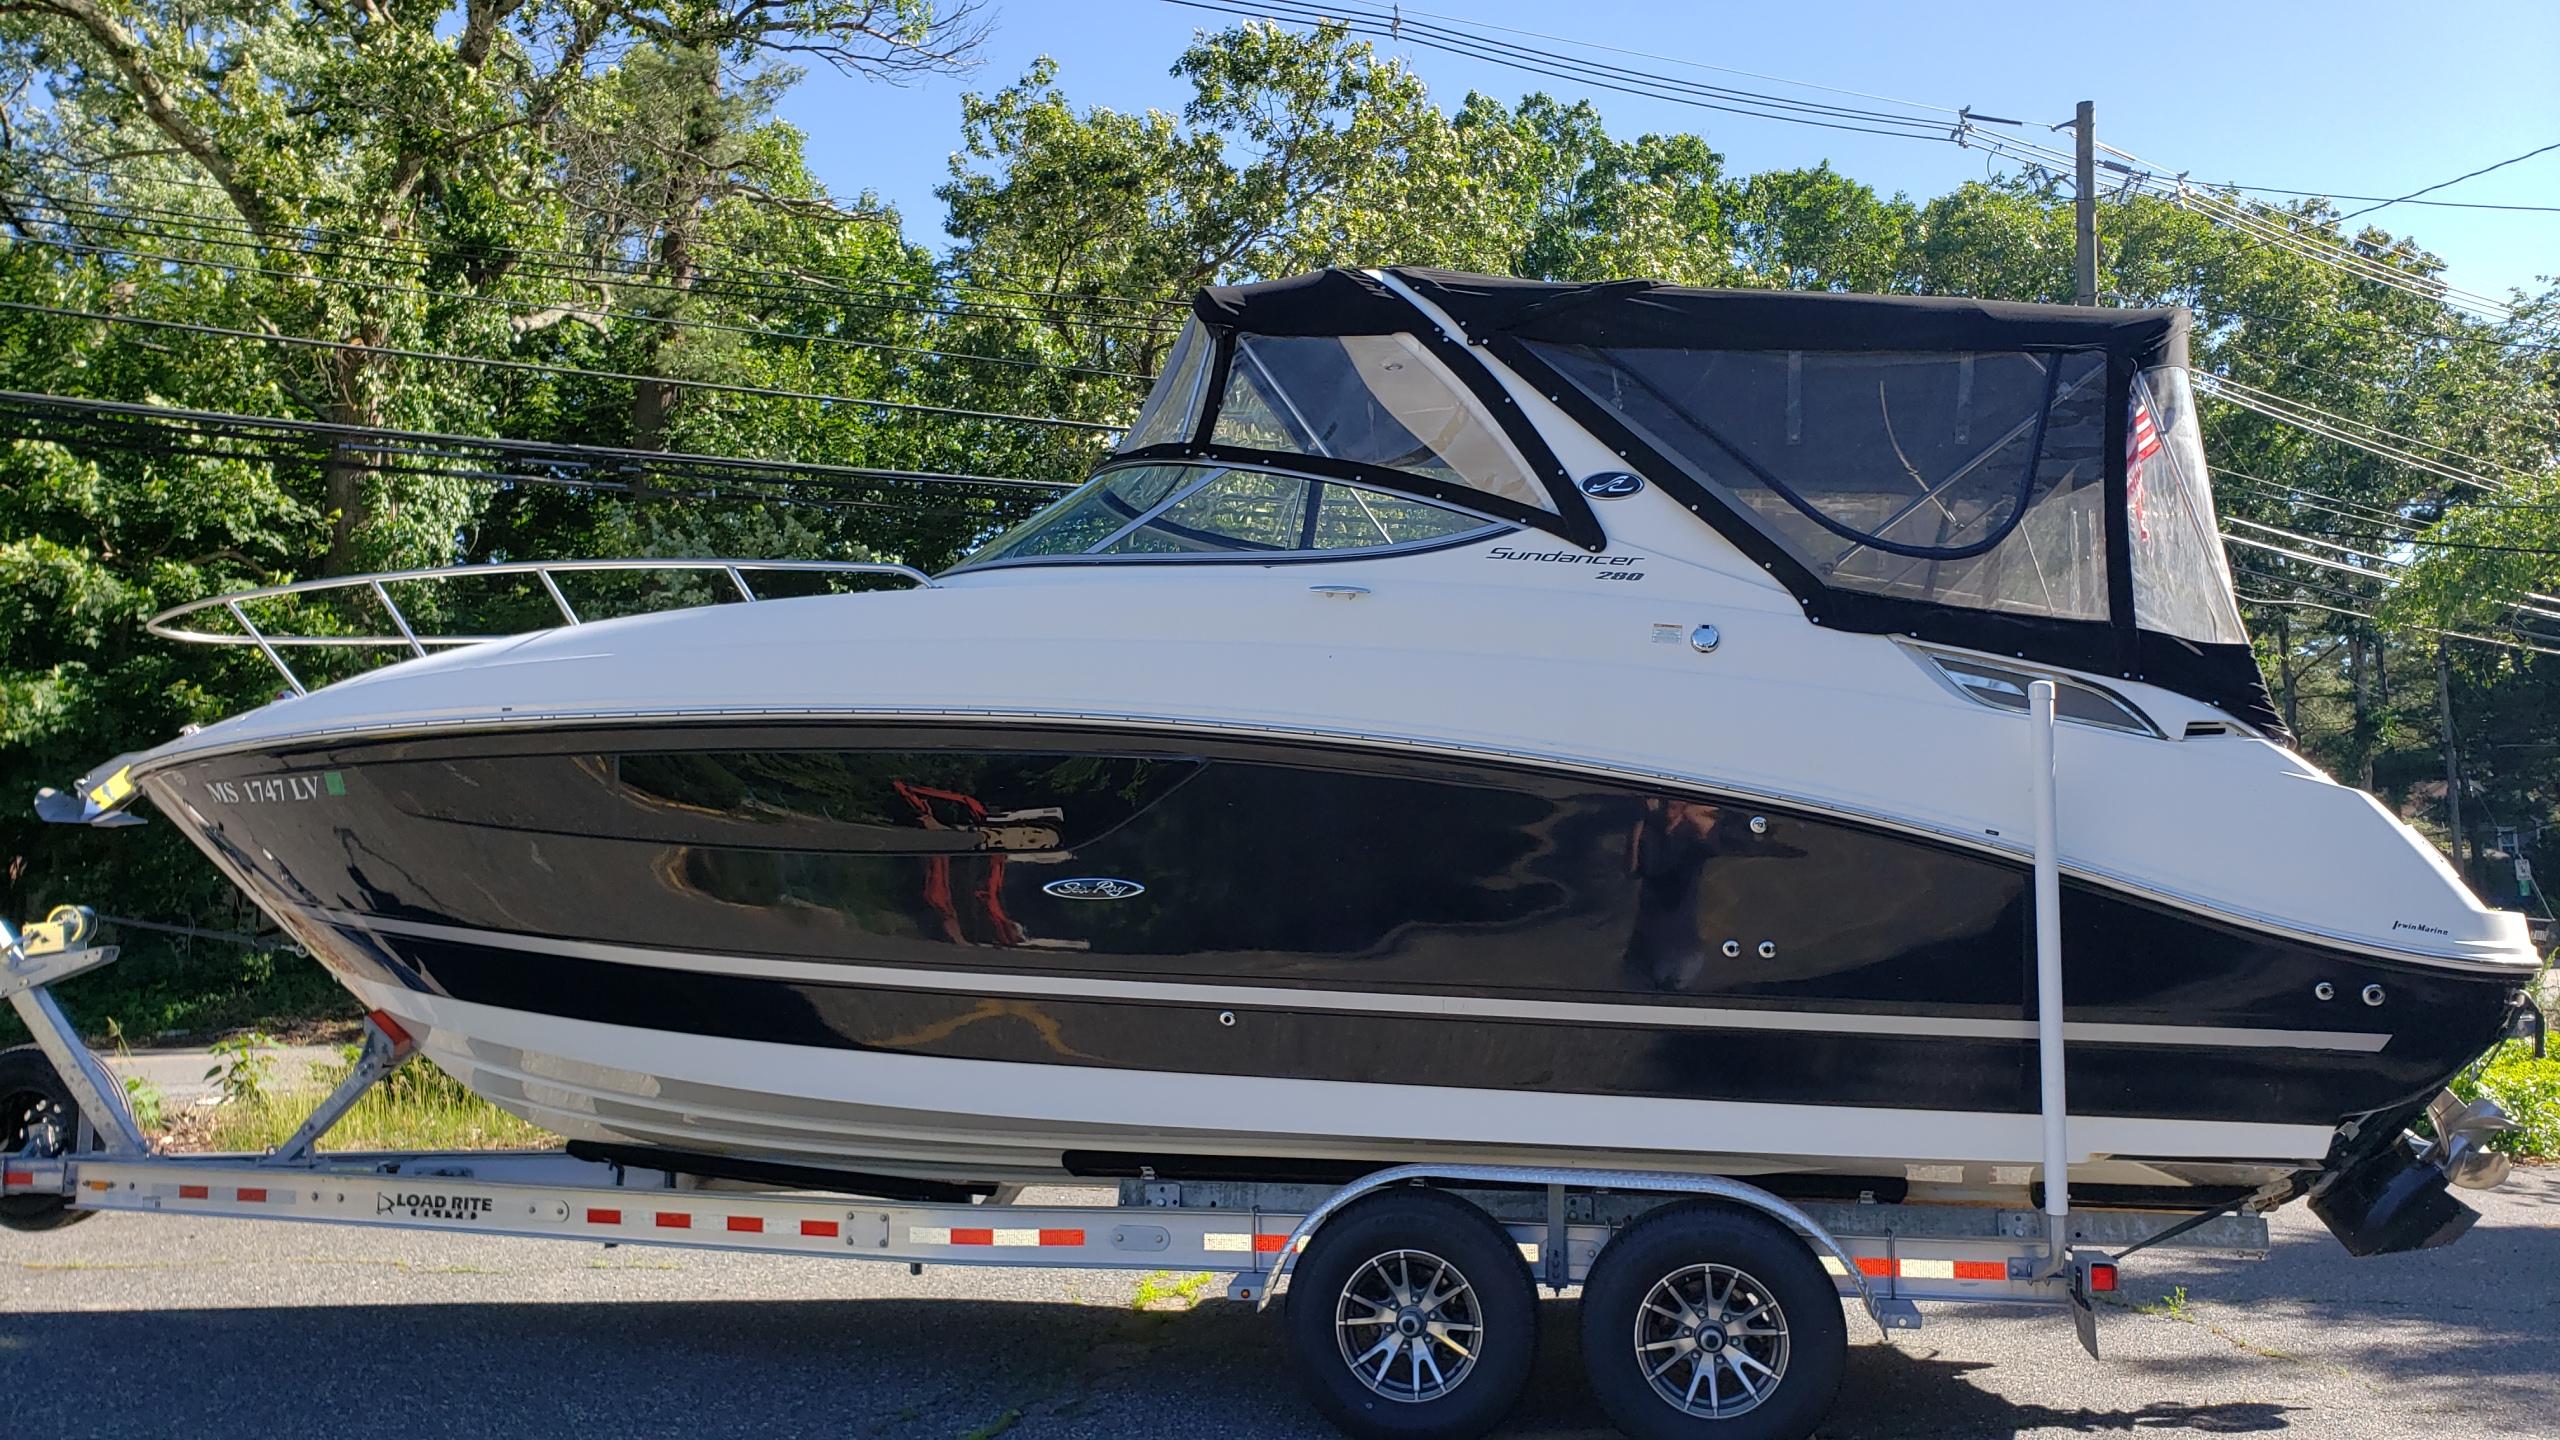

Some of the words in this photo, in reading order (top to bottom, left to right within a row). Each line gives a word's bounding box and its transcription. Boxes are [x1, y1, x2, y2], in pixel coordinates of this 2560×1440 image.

[1486, 547, 1645, 566] Sundancer
[1595, 571, 1645, 581] 280
[205, 781, 239, 803] MS
[243, 778, 285, 803] 1747
[288, 776, 318, 800] LV
[1057, 881, 1089, 894] Sea
[1091, 880, 1128, 897] Ray
[396, 1193, 447, 1209] LOAD
[451, 1196, 493, 1212] RITE
